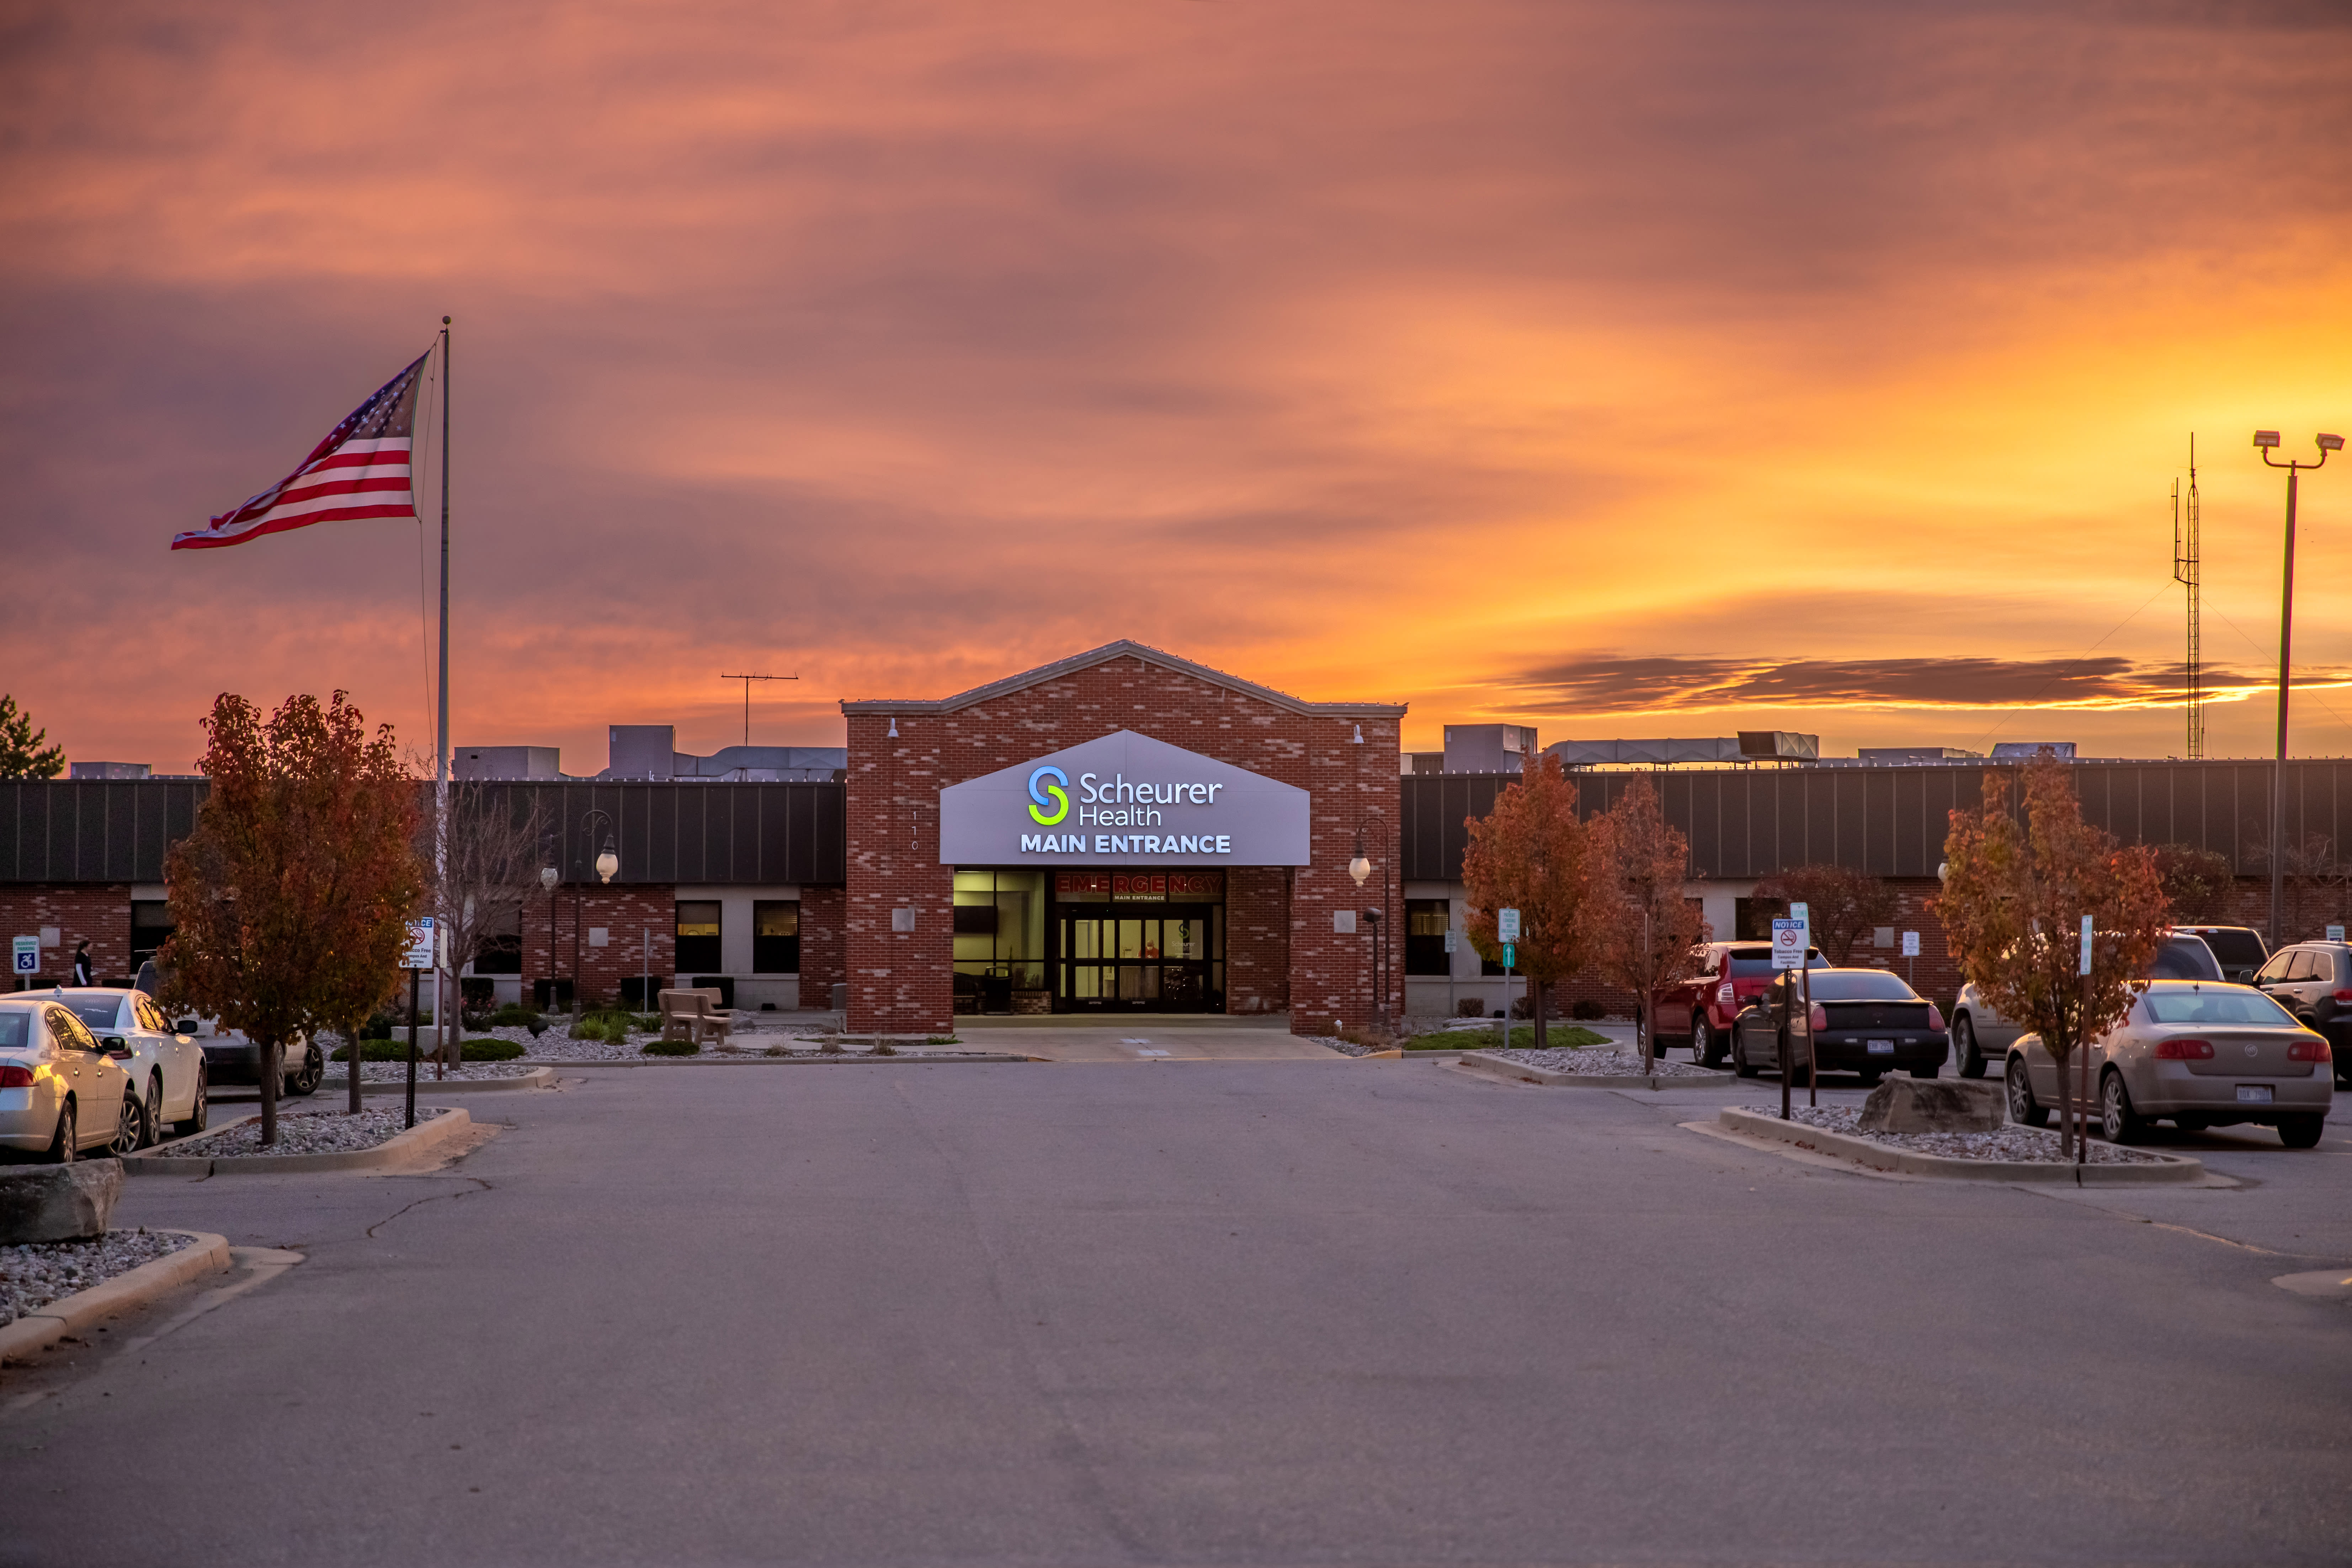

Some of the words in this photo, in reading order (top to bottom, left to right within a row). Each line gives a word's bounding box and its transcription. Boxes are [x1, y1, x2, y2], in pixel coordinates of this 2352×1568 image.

[1080, 772, 1223, 804] Scheurer
[1079, 805, 1161, 826] Health
[1021, 834, 1086, 853] MAIN
[1095, 835, 1231, 854] ENTRANCE
[1055, 876, 1223, 893] EMERGENCY
